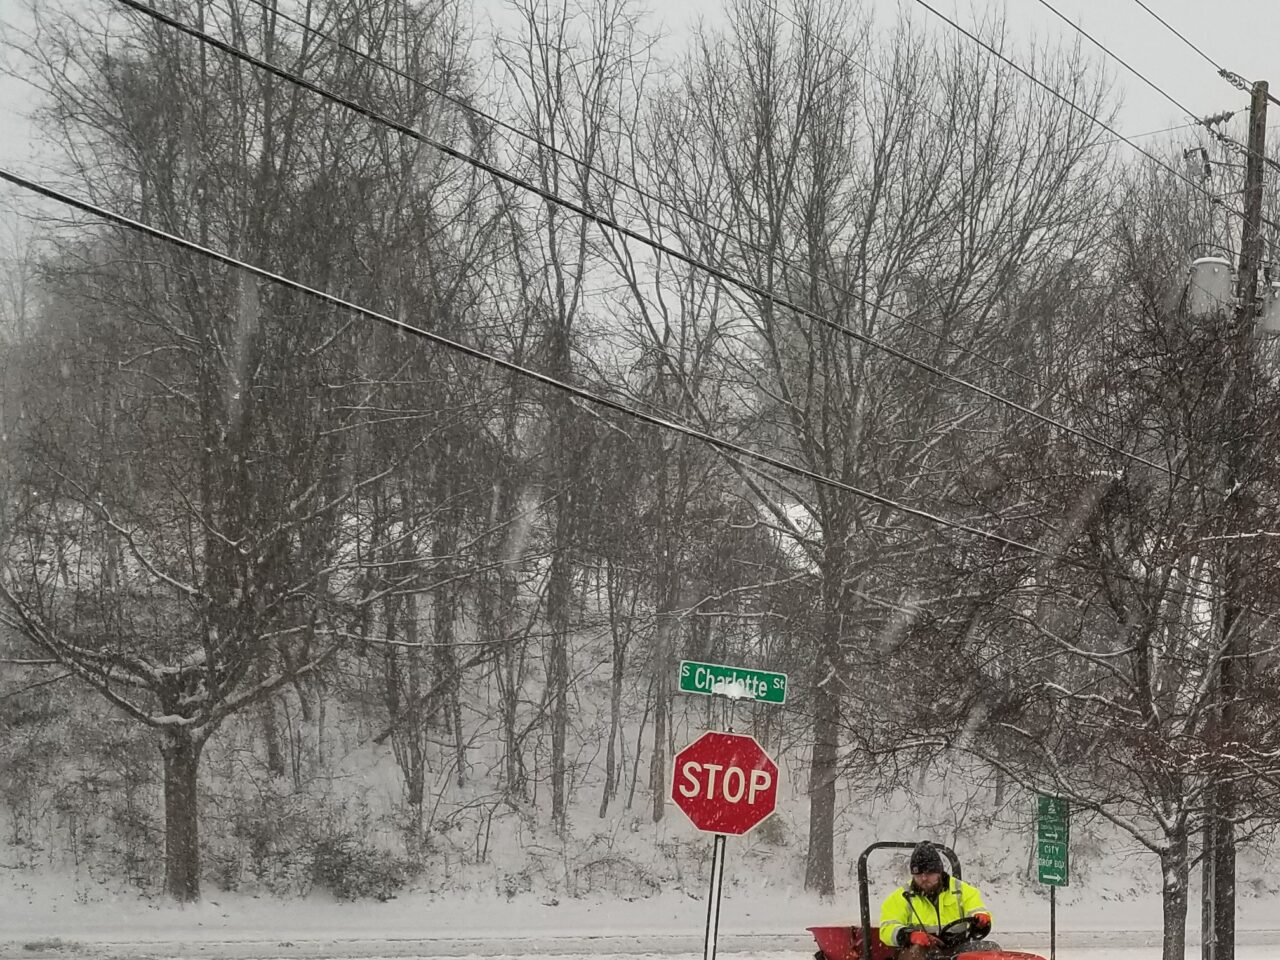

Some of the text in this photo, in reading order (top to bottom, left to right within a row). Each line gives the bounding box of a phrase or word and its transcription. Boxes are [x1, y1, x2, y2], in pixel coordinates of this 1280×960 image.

[682, 665, 691, 677] S
[773, 678, 785, 690] St
[679, 761, 772, 805] STOP
